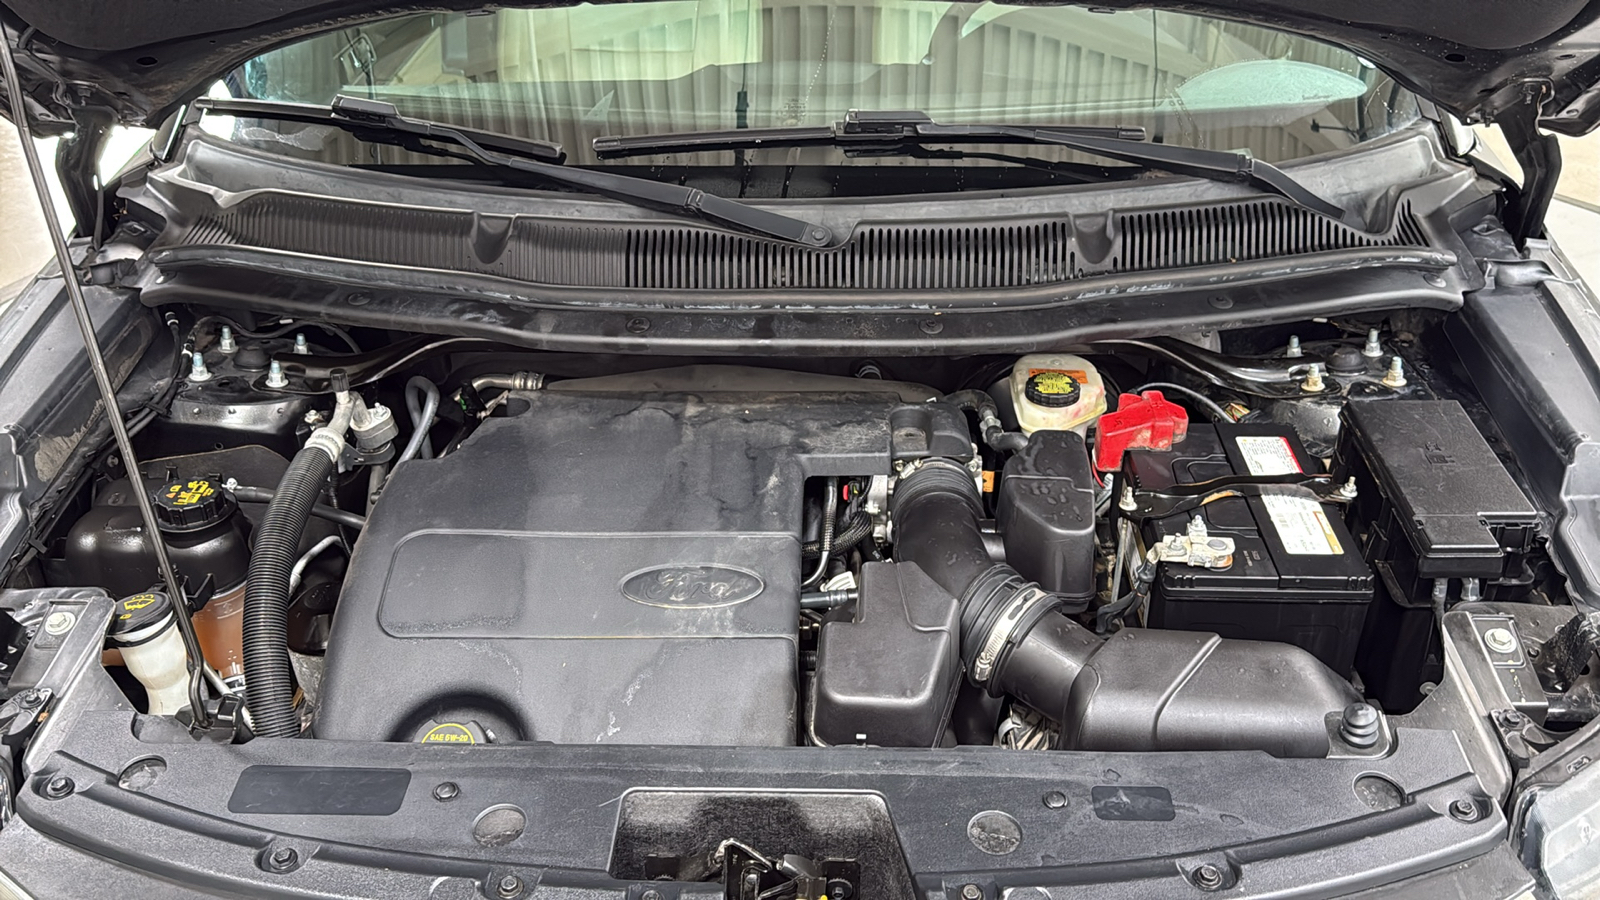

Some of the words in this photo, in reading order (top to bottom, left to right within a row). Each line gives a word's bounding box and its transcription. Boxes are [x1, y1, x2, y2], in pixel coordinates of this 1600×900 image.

[645, 570, 751, 601] Ford
[429, 733, 445, 741] SAE
[445, 733, 469, 742] 5W-20
